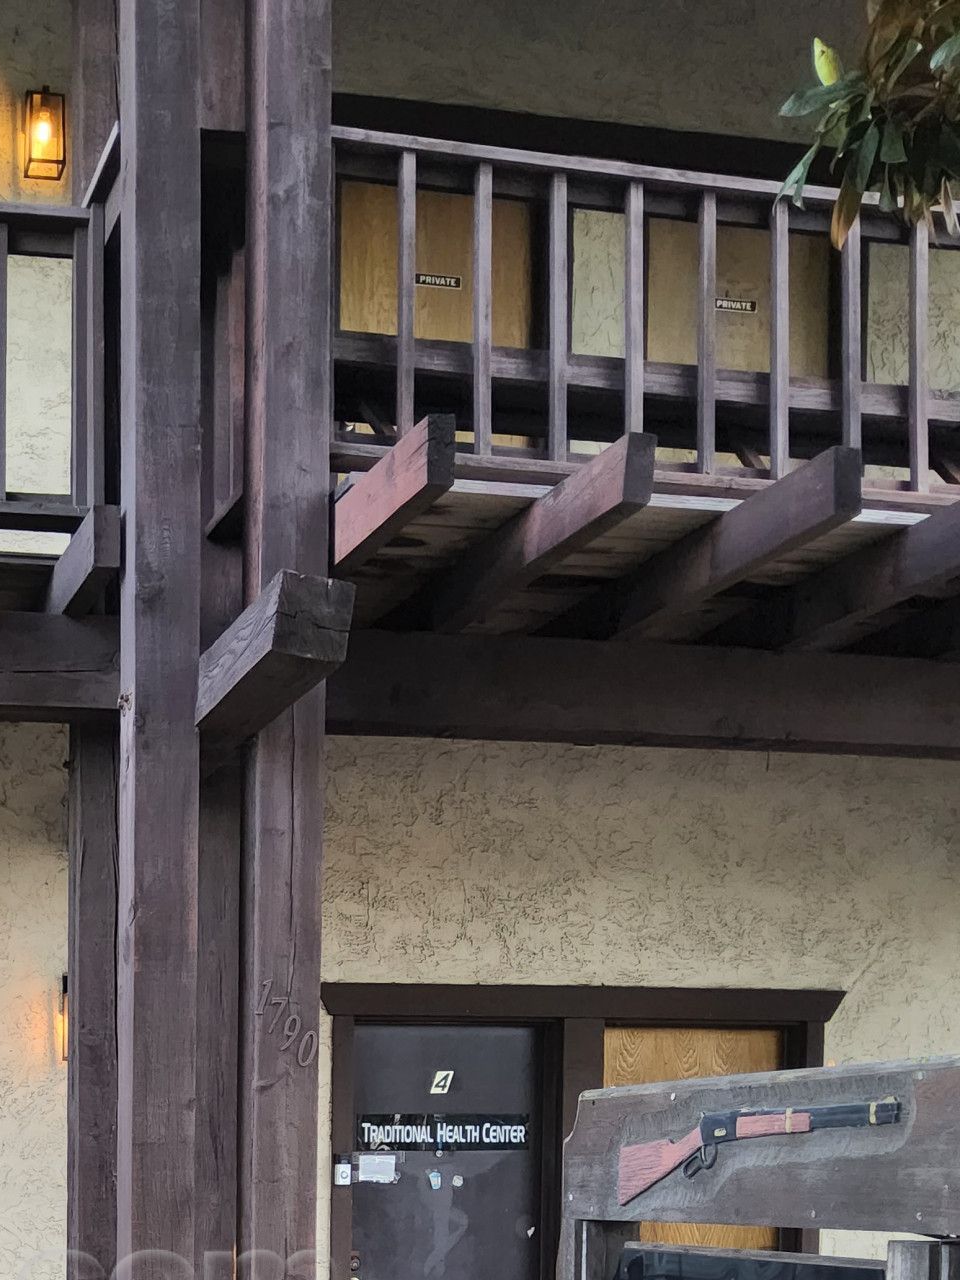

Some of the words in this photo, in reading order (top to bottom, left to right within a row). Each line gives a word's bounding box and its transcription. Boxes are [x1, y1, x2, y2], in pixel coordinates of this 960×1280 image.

[419, 275, 457, 286] PRIVATE
[716, 300, 752, 311] PRIVATE
[254, 979, 318, 1067] 1790
[434, 1073, 450, 1092] 4
[362, 1122, 434, 1143] TRADITIONAL
[437, 1122, 480, 1143] HEALTH
[482, 1122, 526, 1143] CENTER
